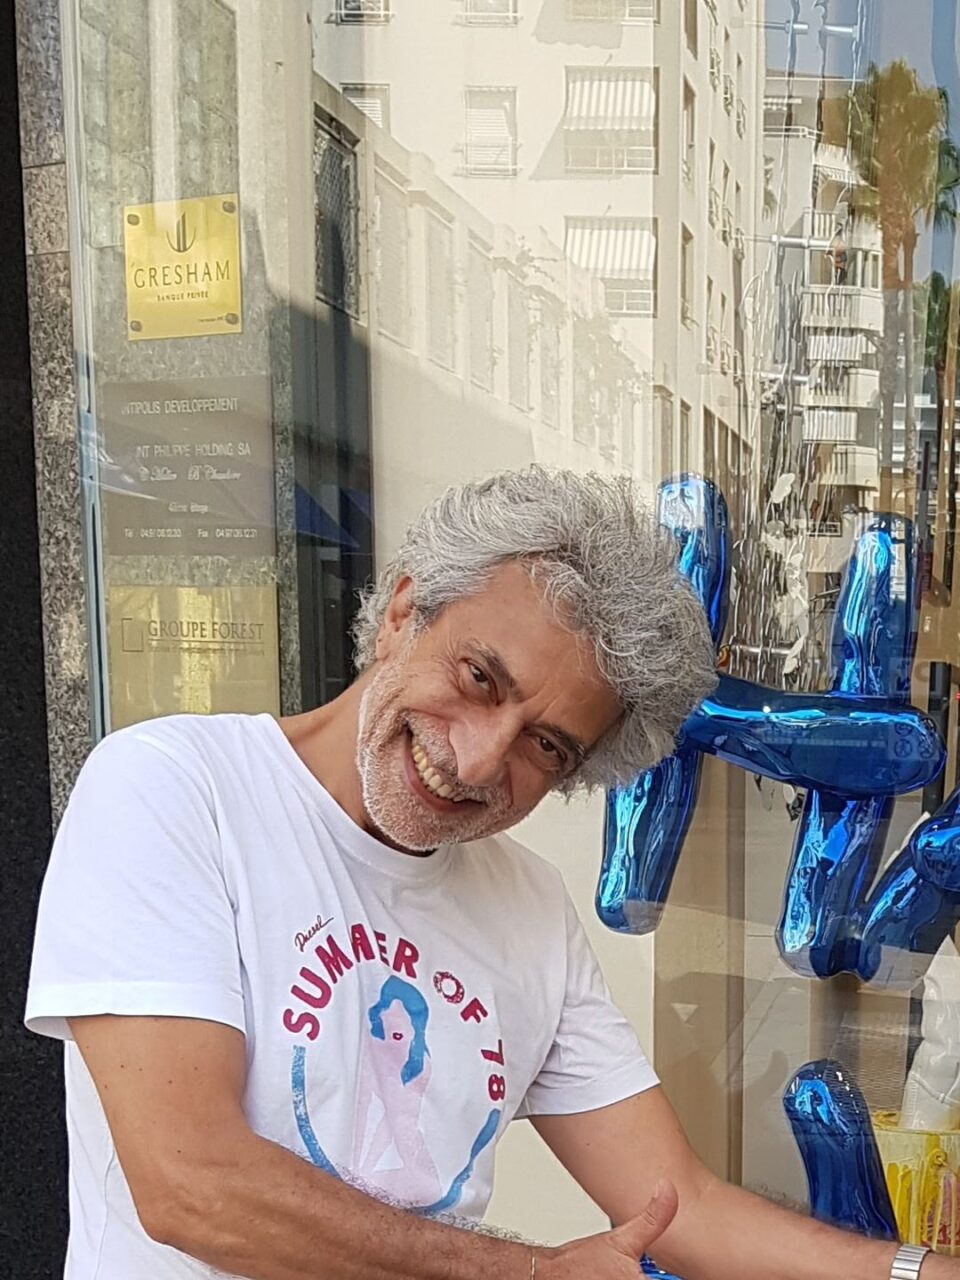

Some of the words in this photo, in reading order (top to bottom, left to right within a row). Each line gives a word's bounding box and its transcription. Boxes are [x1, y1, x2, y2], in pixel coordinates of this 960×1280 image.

[134, 260, 231, 288] GRESHAM
[148, 621, 207, 638] GROUPE
[212, 622, 264, 640] FOREST
[433, 970, 489, 1025] OF
[481, 1038, 507, 1102] 78
